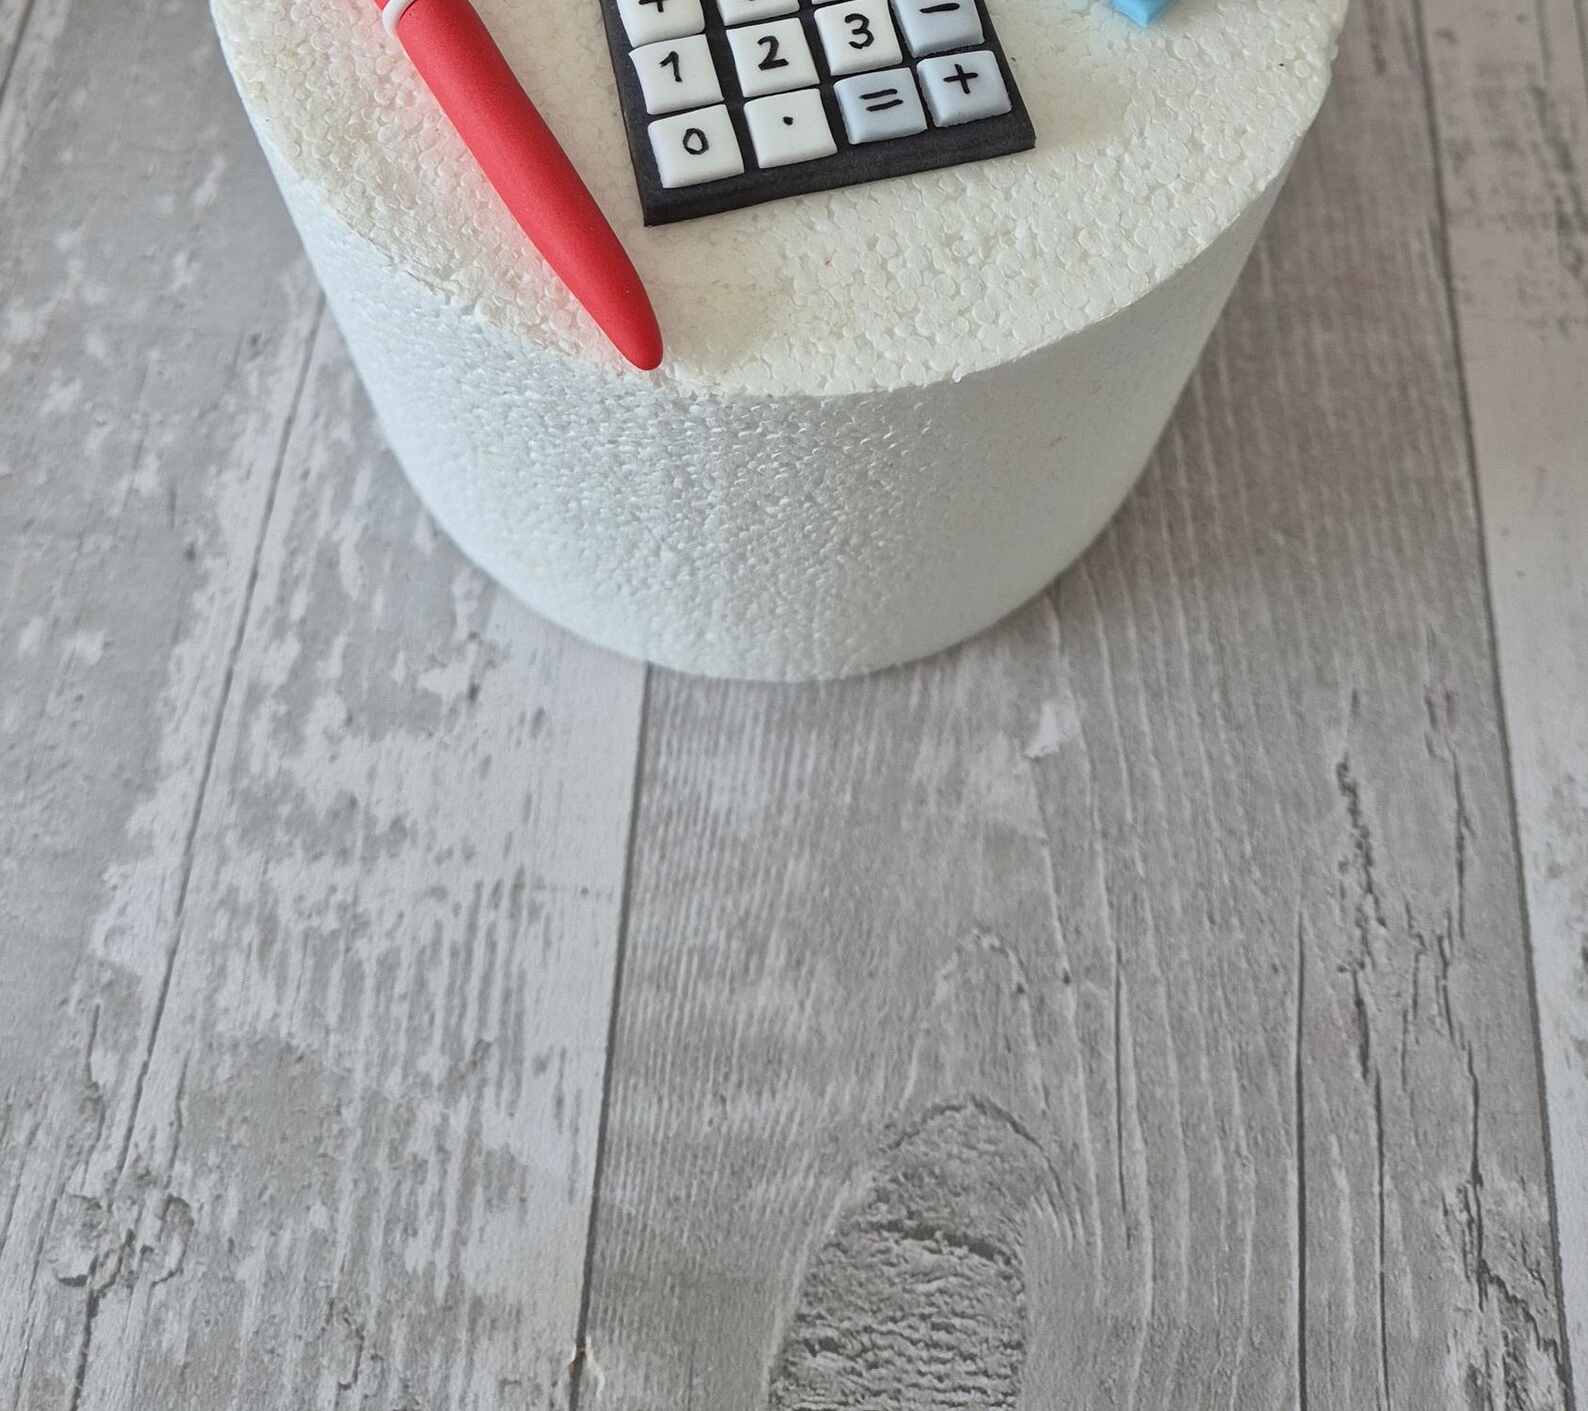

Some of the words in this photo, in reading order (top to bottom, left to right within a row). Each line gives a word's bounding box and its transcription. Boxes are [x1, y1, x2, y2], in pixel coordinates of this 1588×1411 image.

[659, 50, 683, 83] 1
[756, 35, 790, 72] 2
[844, 12, 875, 50] 3
[682, 127, 710, 156] 0
